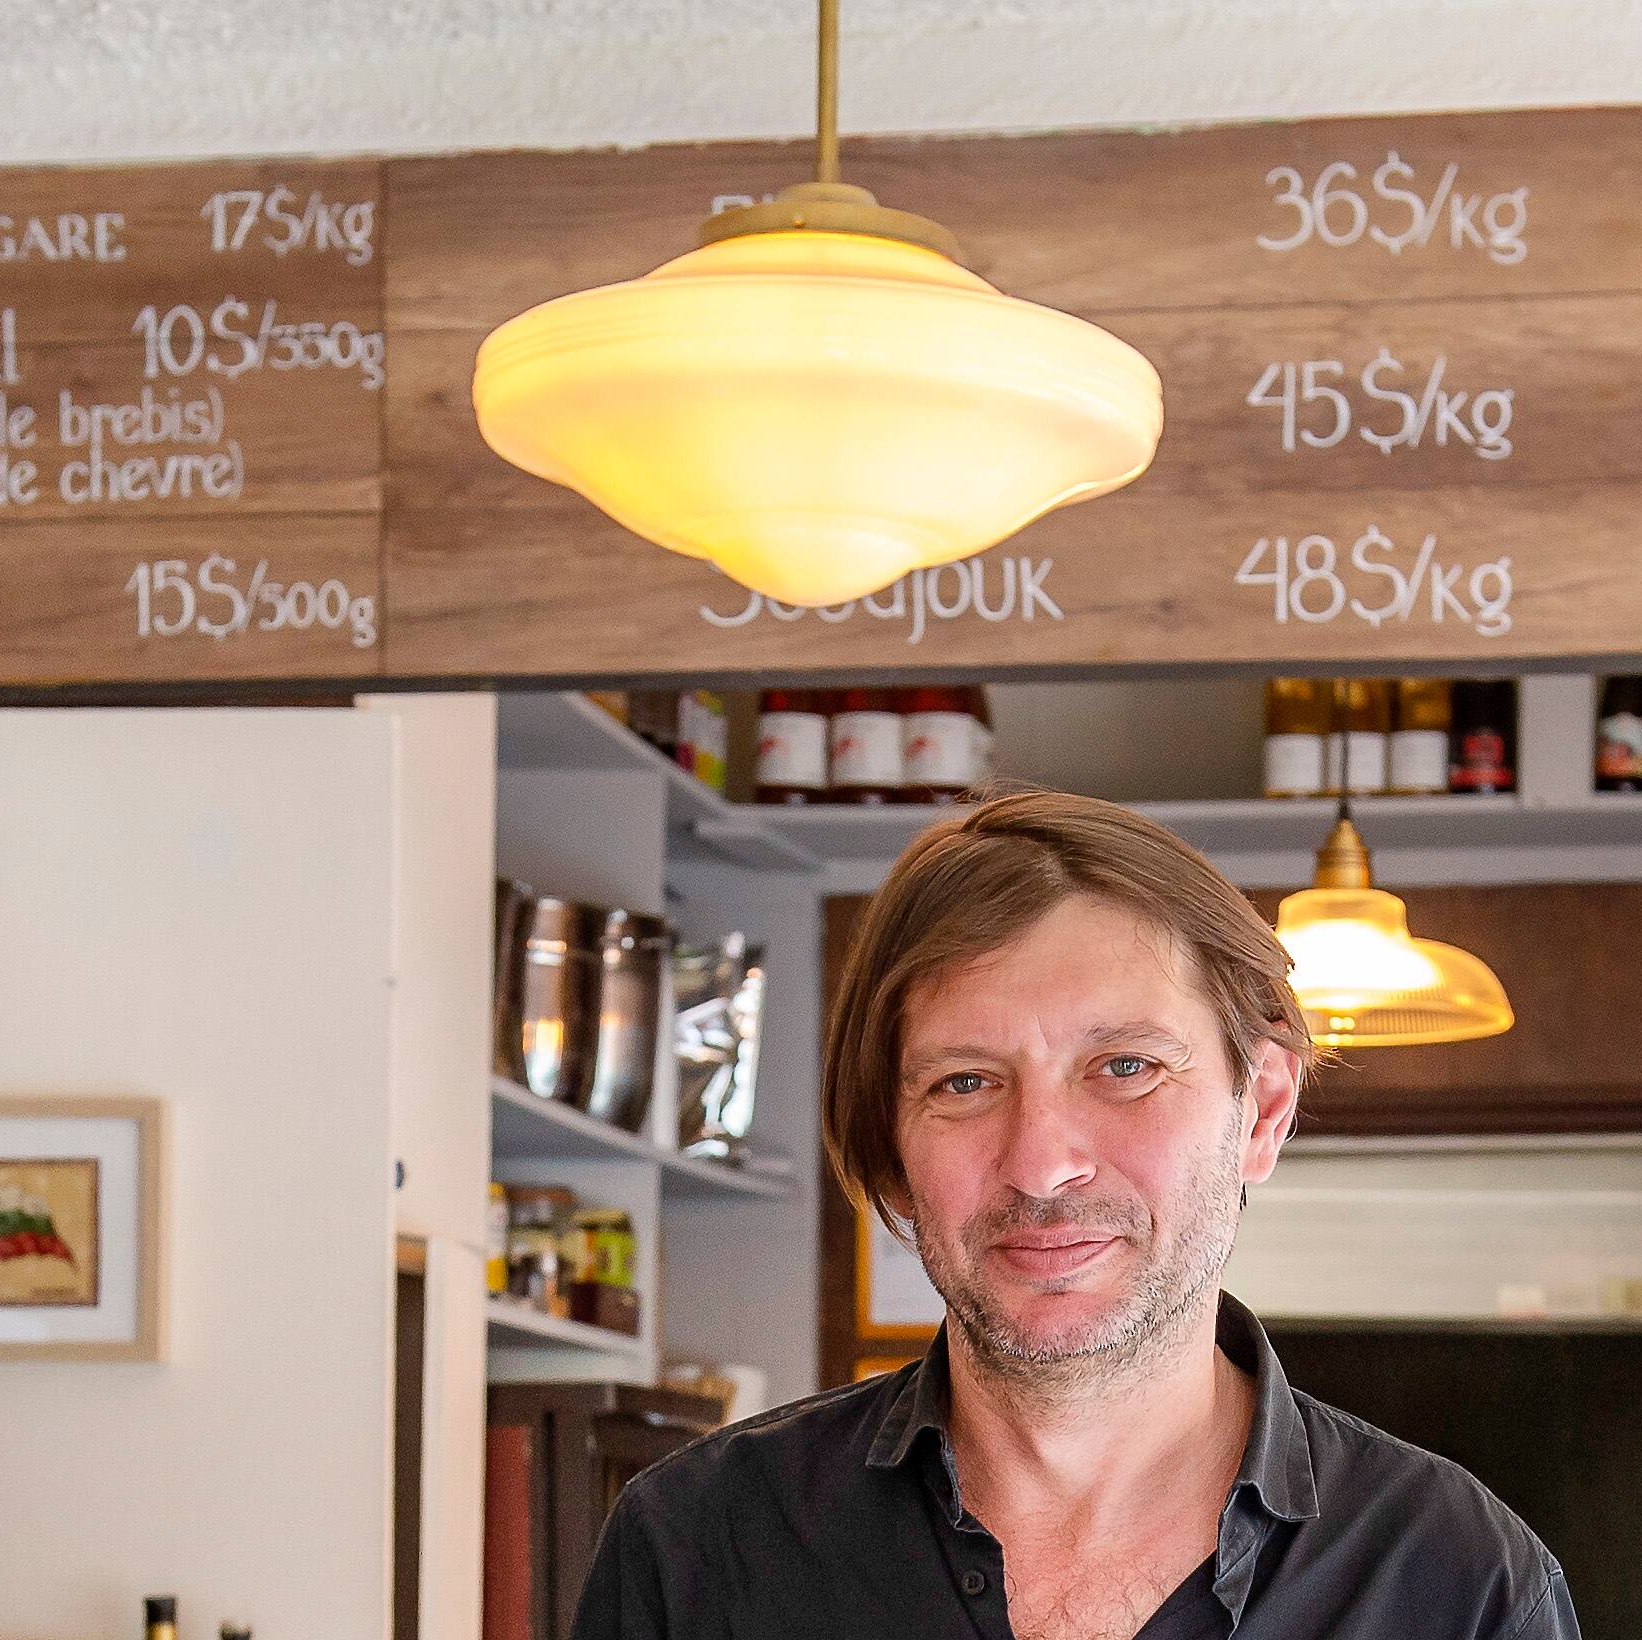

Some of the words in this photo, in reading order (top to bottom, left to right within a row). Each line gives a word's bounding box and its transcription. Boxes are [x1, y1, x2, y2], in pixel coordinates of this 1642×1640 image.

[200, 184, 375, 267] 17$/kg
[1257, 150, 1530, 265] 36$/kg
[1245, 347, 1514, 460] 45$/kg
[1234, 523, 1514, 637] 48$/kg
